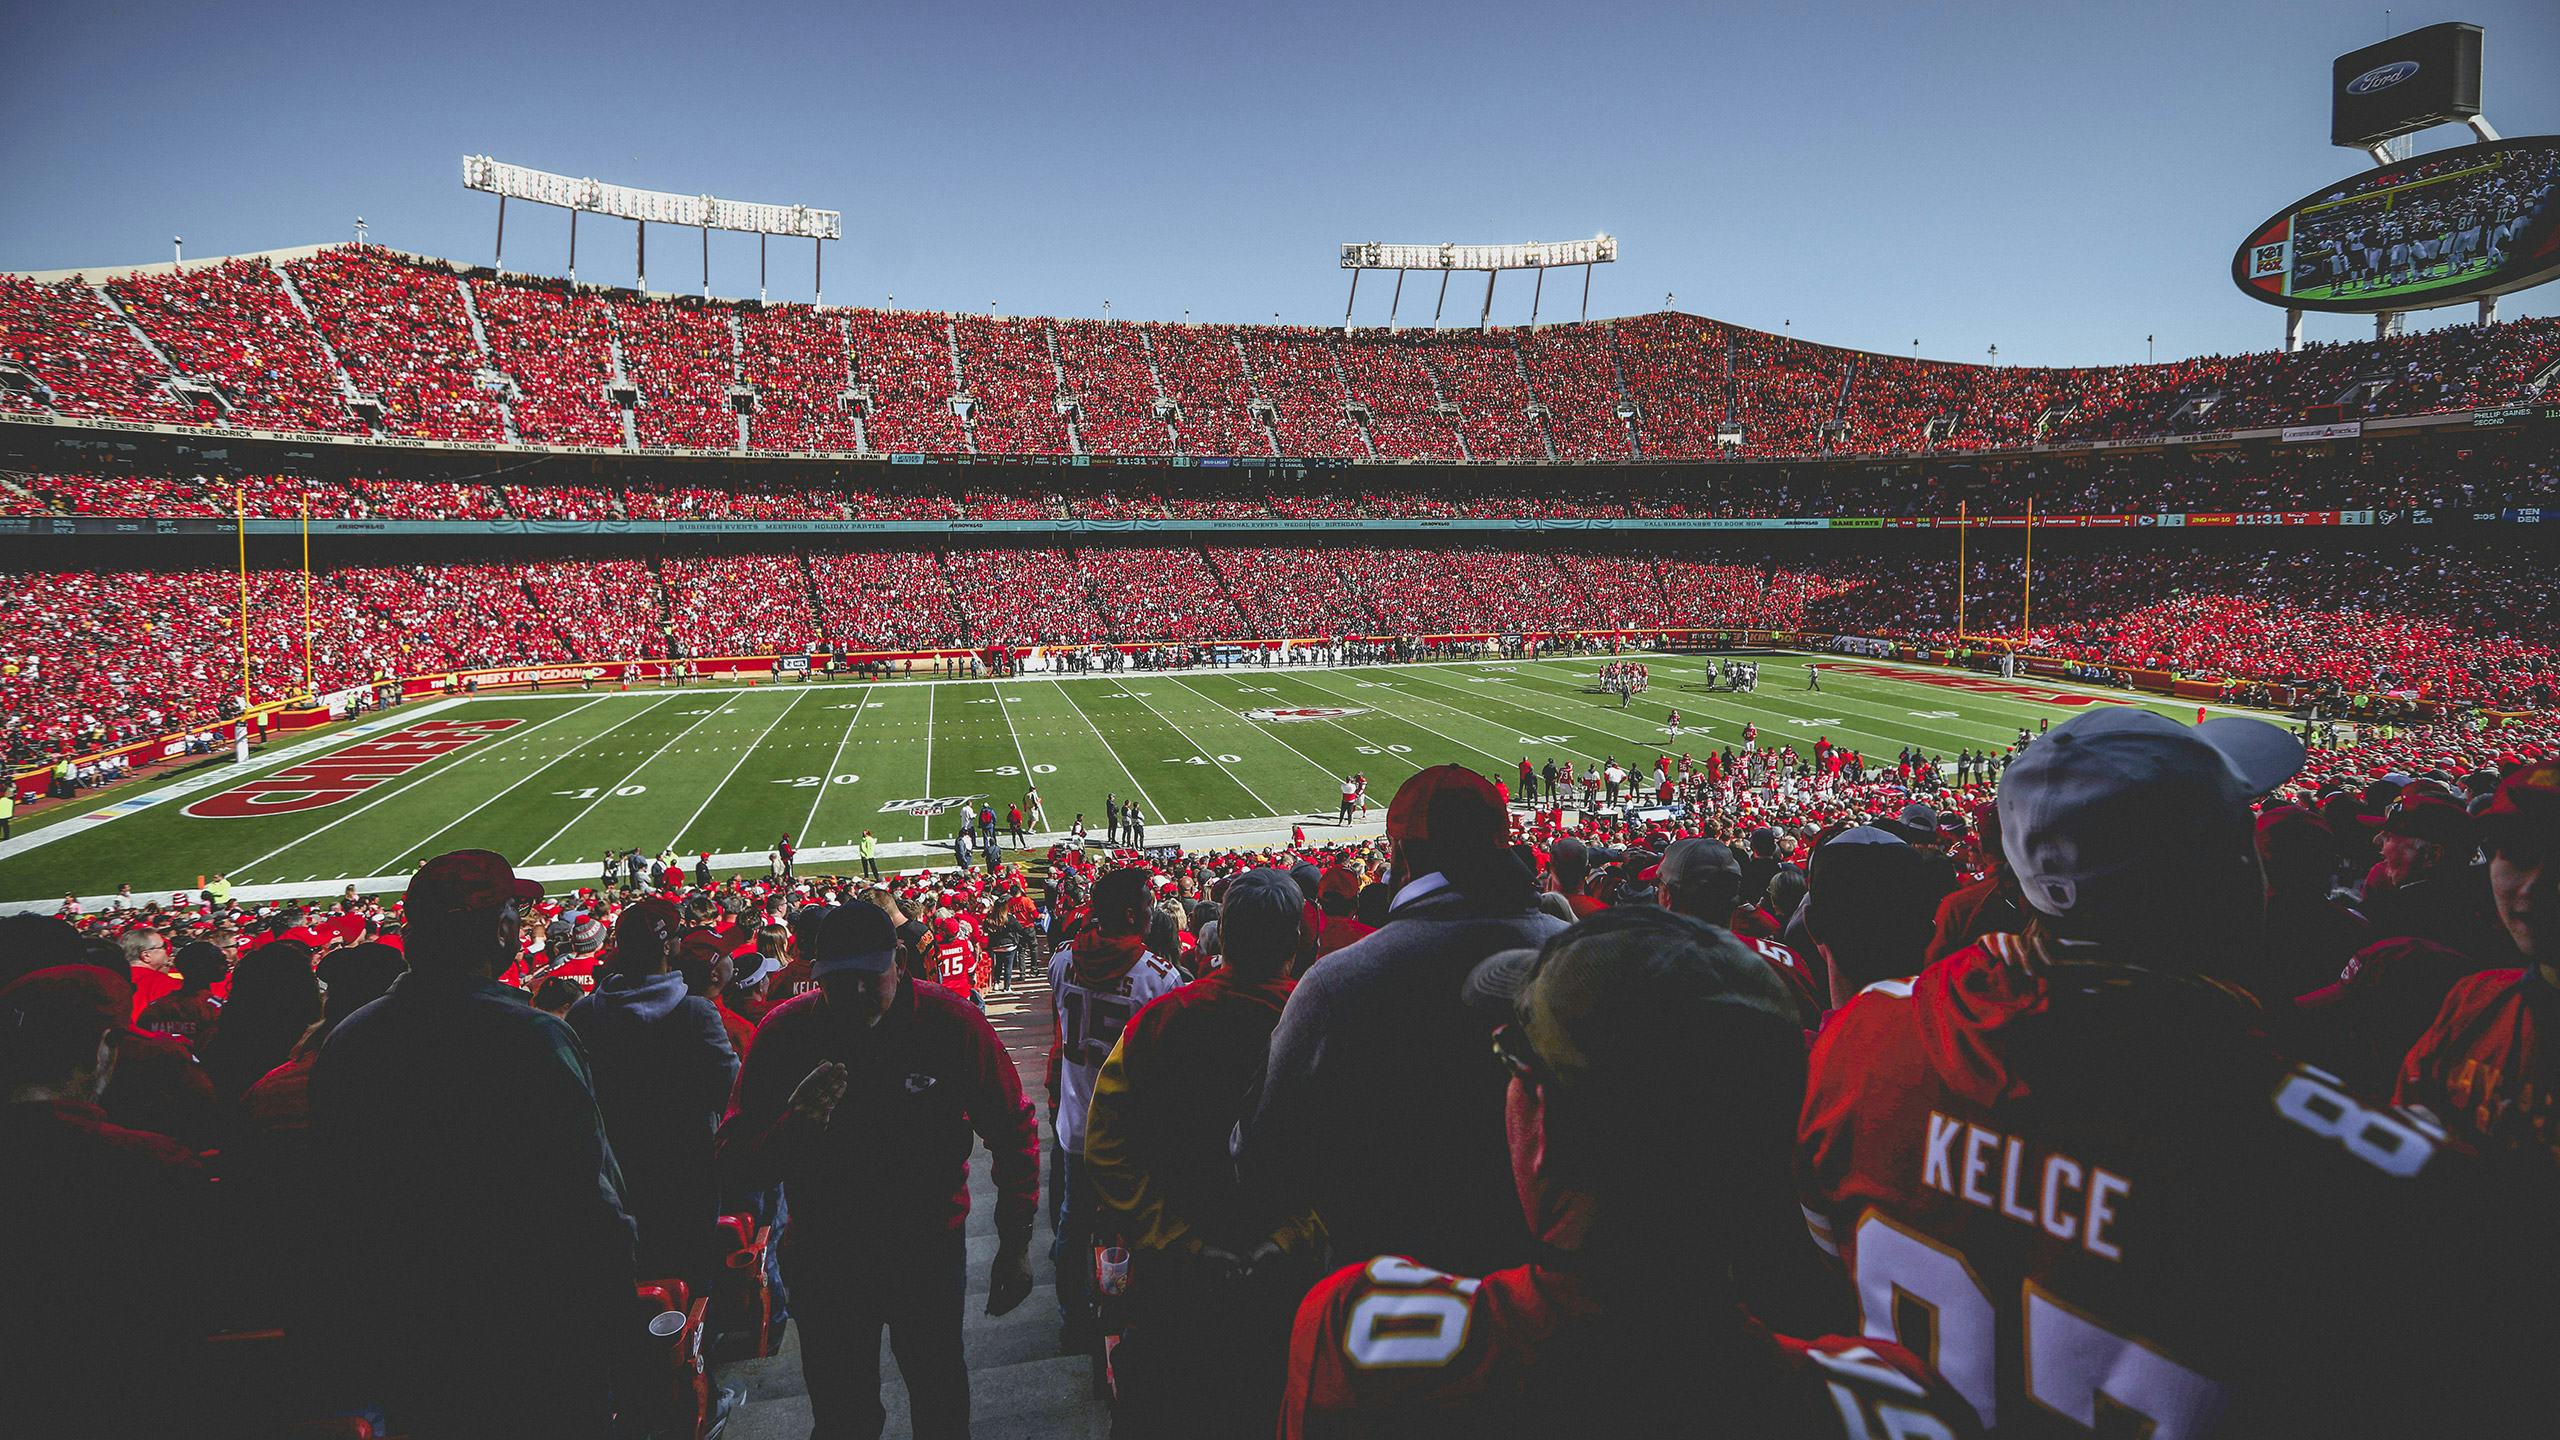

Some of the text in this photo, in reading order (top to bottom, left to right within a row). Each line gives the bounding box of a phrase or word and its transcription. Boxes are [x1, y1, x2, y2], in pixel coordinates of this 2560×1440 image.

[2360, 66, 2403, 91] Ford
[10, 414, 54, 426] HAYNES
[97, 421, 155, 431] STENERUD
[2474, 418, 2504, 426] SECOND
[189, 427, 254, 438] S. HEADRICK
[296, 434, 335, 443] RUDNAY
[2200, 433, 2232, 441] WATERS
[2236, 514, 2283, 524] 11:31
[462, 672, 511, 687] CHIEFS
[1519, 735, 1567, 745] 40
[1355, 744, 1412, 756] 50
[1185, 754, 1242, 765] 40
[179, 719, 526, 819] CHIEFS
[996, 764, 1057, 776] 30
[792, 774, 860, 788] 20
[570, 785, 647, 799] 10
[942, 956, 964, 977] 15
[1922, 1110, 2132, 1261] KELCE
